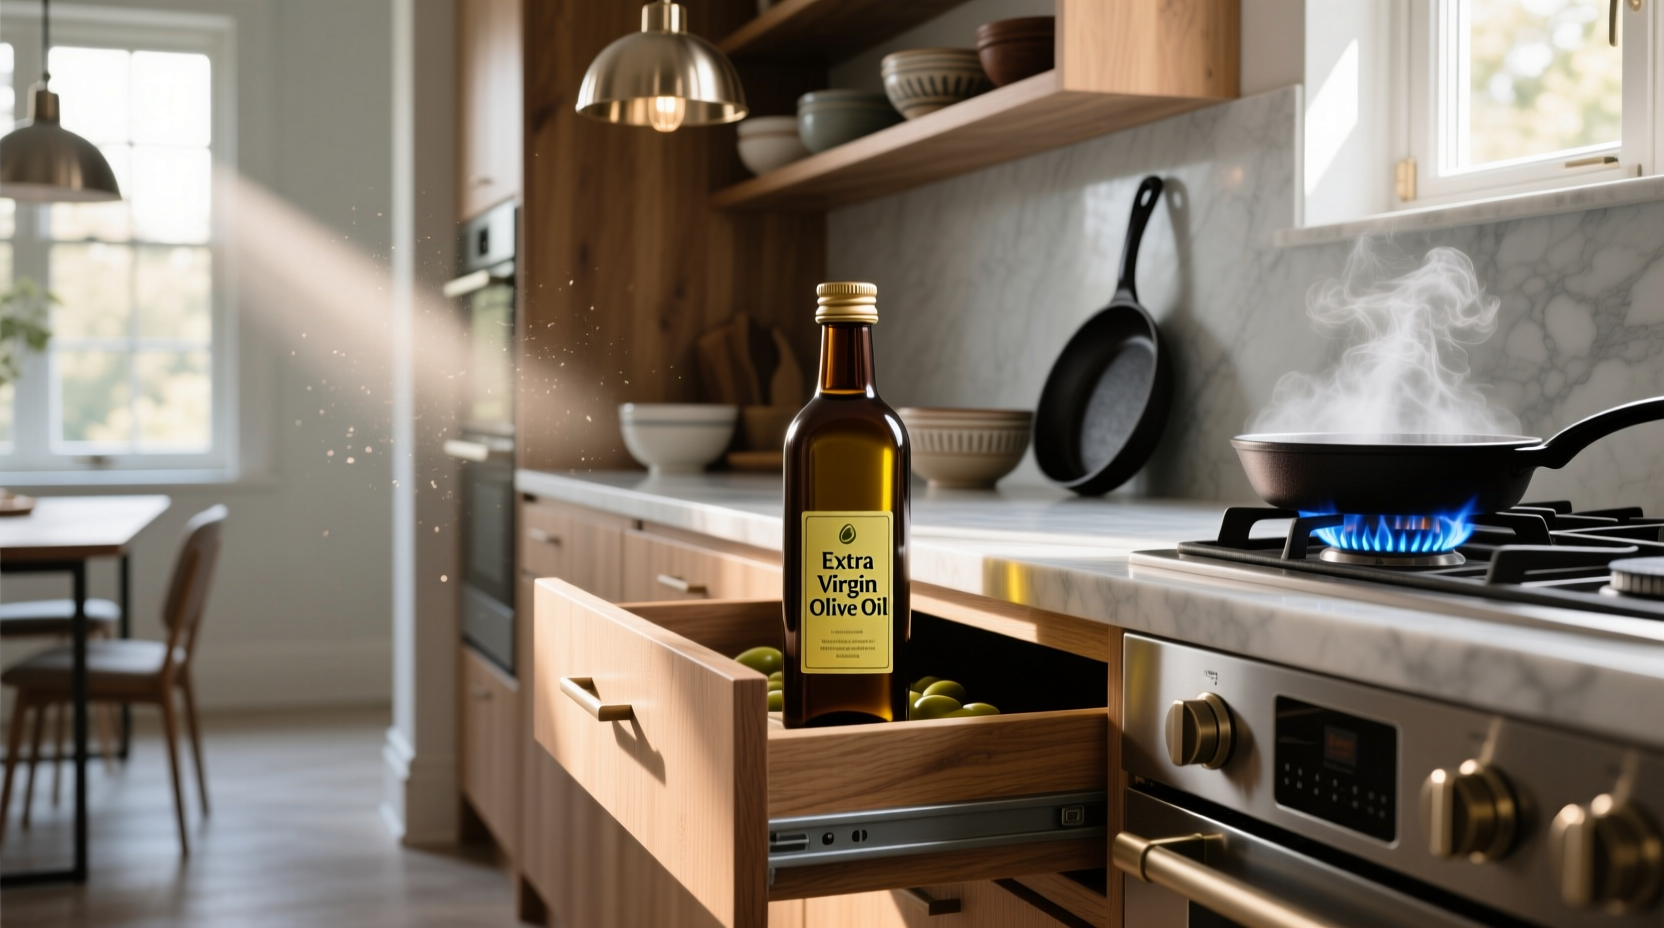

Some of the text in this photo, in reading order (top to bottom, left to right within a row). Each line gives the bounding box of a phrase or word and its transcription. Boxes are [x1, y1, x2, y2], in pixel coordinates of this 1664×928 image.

[822, 551, 874, 570] Extra
[817, 574, 878, 599] Virgin
[809, 597, 889, 617] Olive Oil
